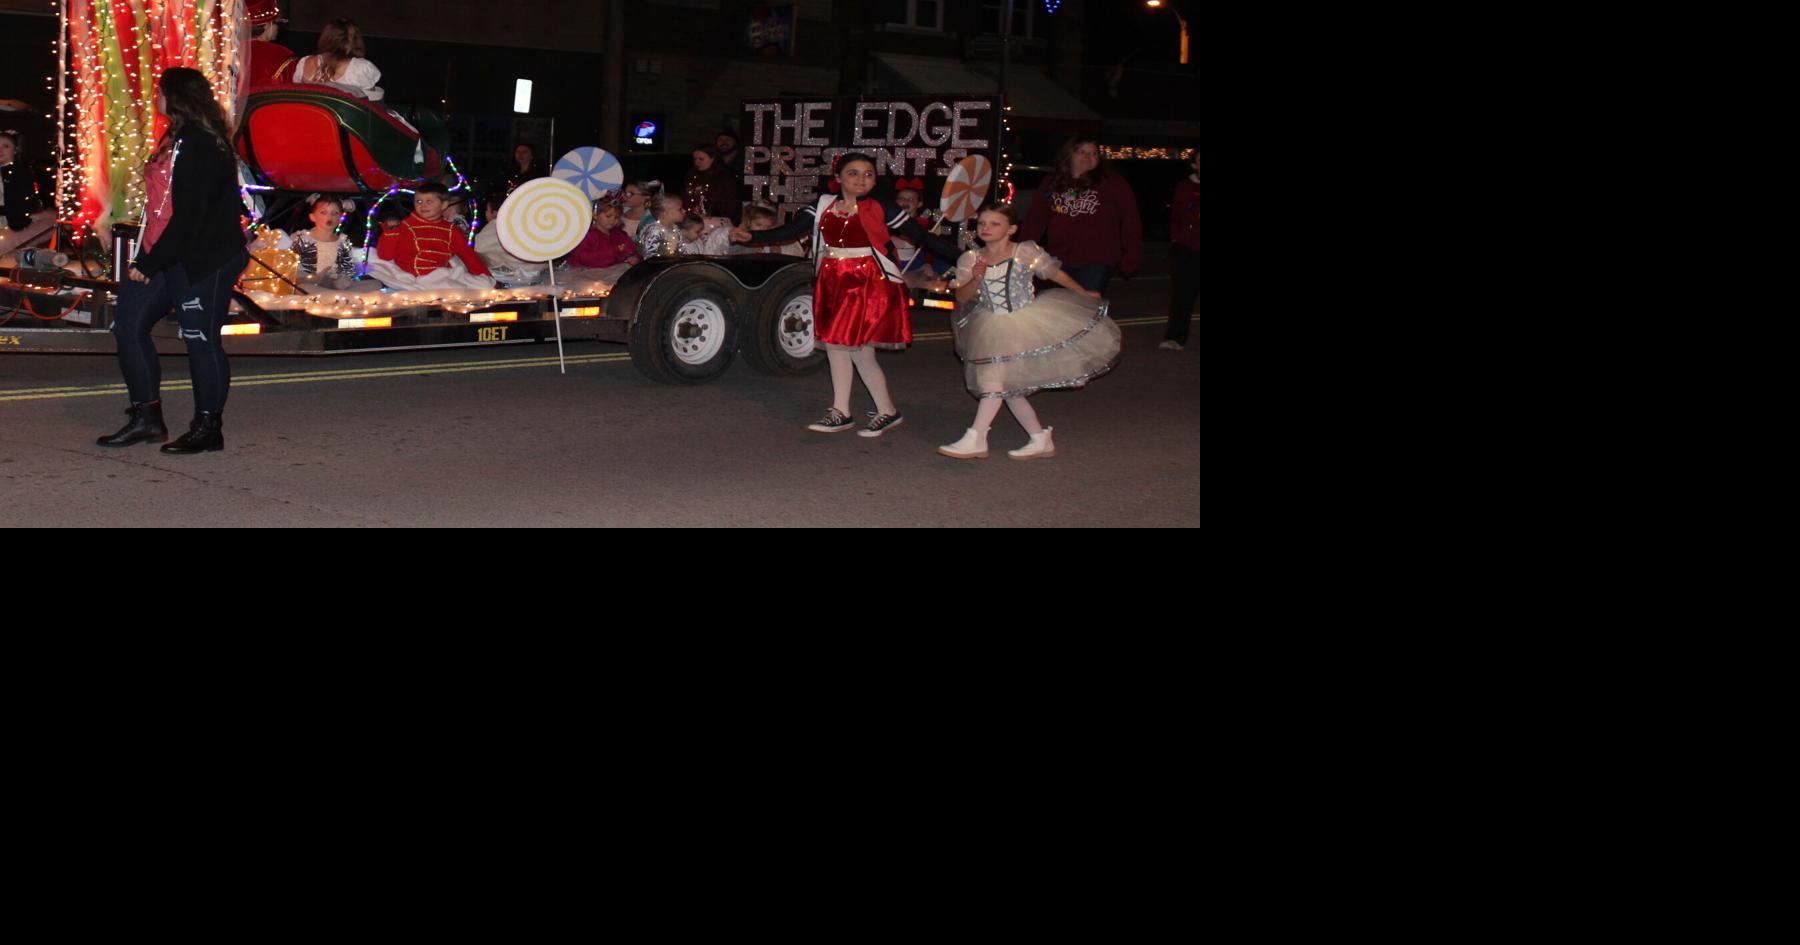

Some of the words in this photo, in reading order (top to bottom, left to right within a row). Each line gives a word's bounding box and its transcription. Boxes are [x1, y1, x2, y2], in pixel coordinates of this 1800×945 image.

[744, 102, 832, 146] THE
[852, 101, 991, 149] EDGE
[744, 146, 968, 176] PRESNTS
[743, 175, 820, 203] THE
